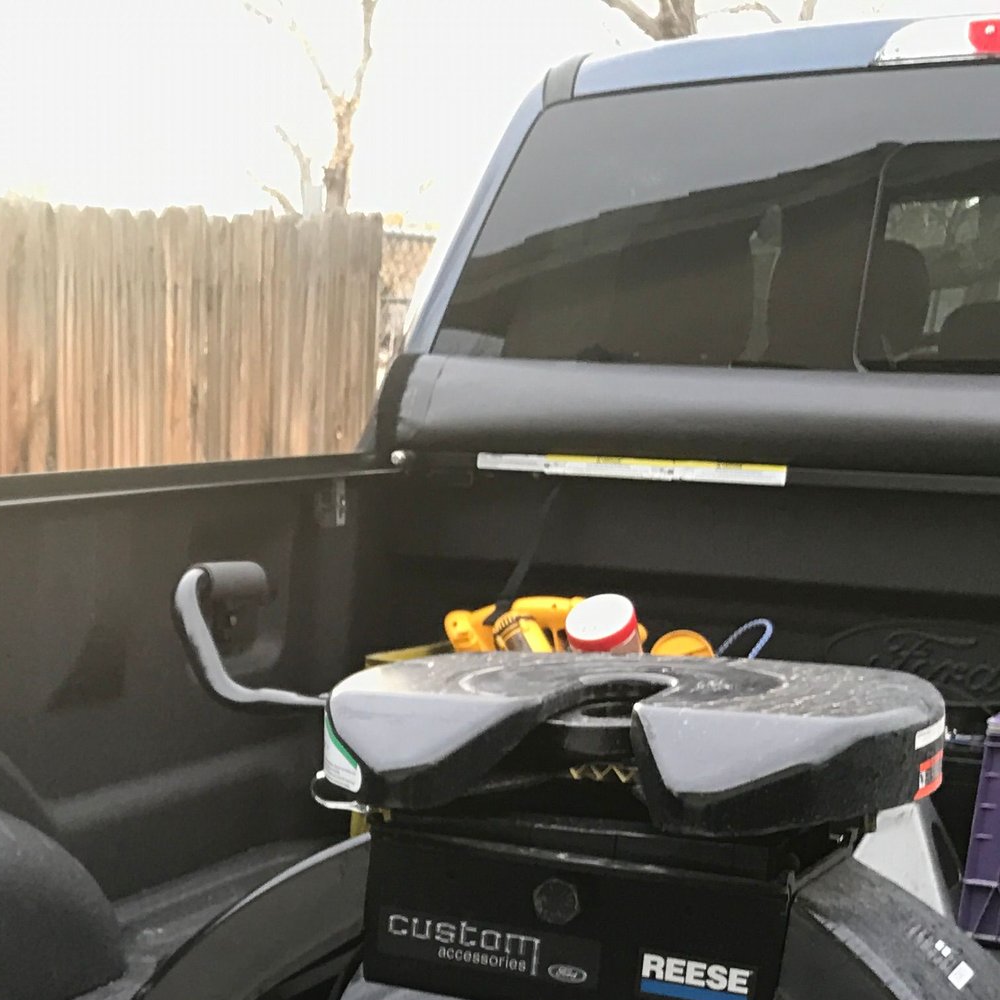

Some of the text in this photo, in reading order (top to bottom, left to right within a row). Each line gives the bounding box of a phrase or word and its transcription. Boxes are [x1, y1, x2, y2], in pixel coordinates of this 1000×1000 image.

[387, 913, 541, 977] custom
[437, 945, 527, 973] accessories
[641, 952, 750, 995] REESE
